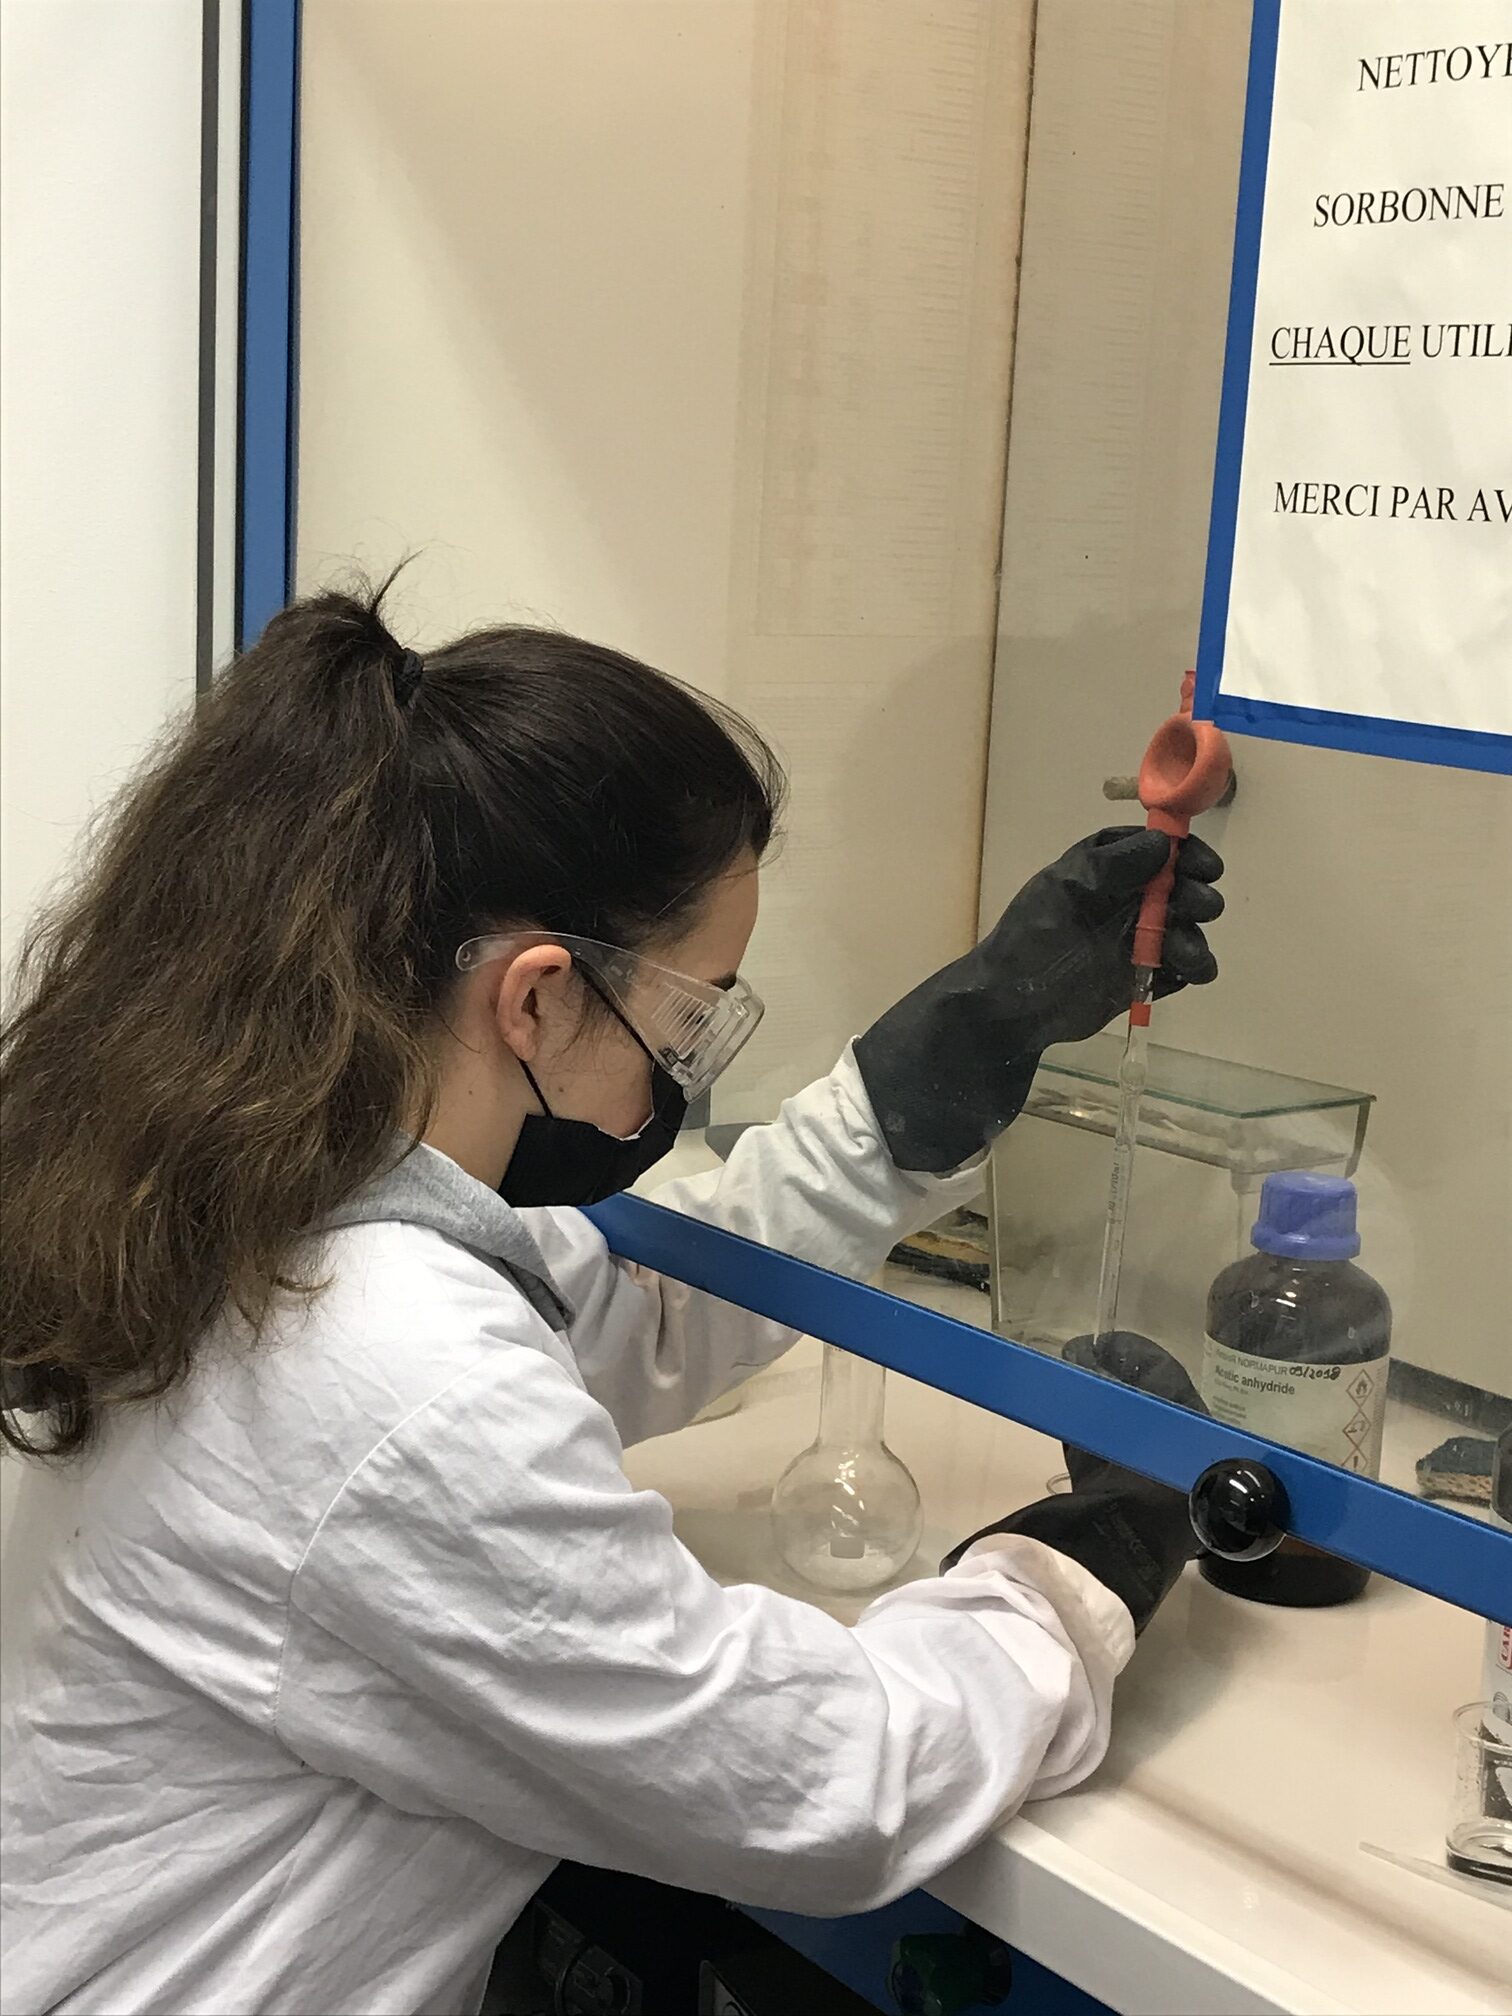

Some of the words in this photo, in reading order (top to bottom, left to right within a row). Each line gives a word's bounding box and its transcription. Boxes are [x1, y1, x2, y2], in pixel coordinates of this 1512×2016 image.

[1313, 183, 1505, 228] SORBONNE
[1269, 325, 1412, 366] CHAQUE
[1273, 481, 1381, 518] MERCI
[1389, 485, 1458, 521] PAR
[1466, 488, 1512, 524] AV
[1214, 1364, 1240, 1384] Acetic
[1240, 1375, 1296, 1396] anhydride
